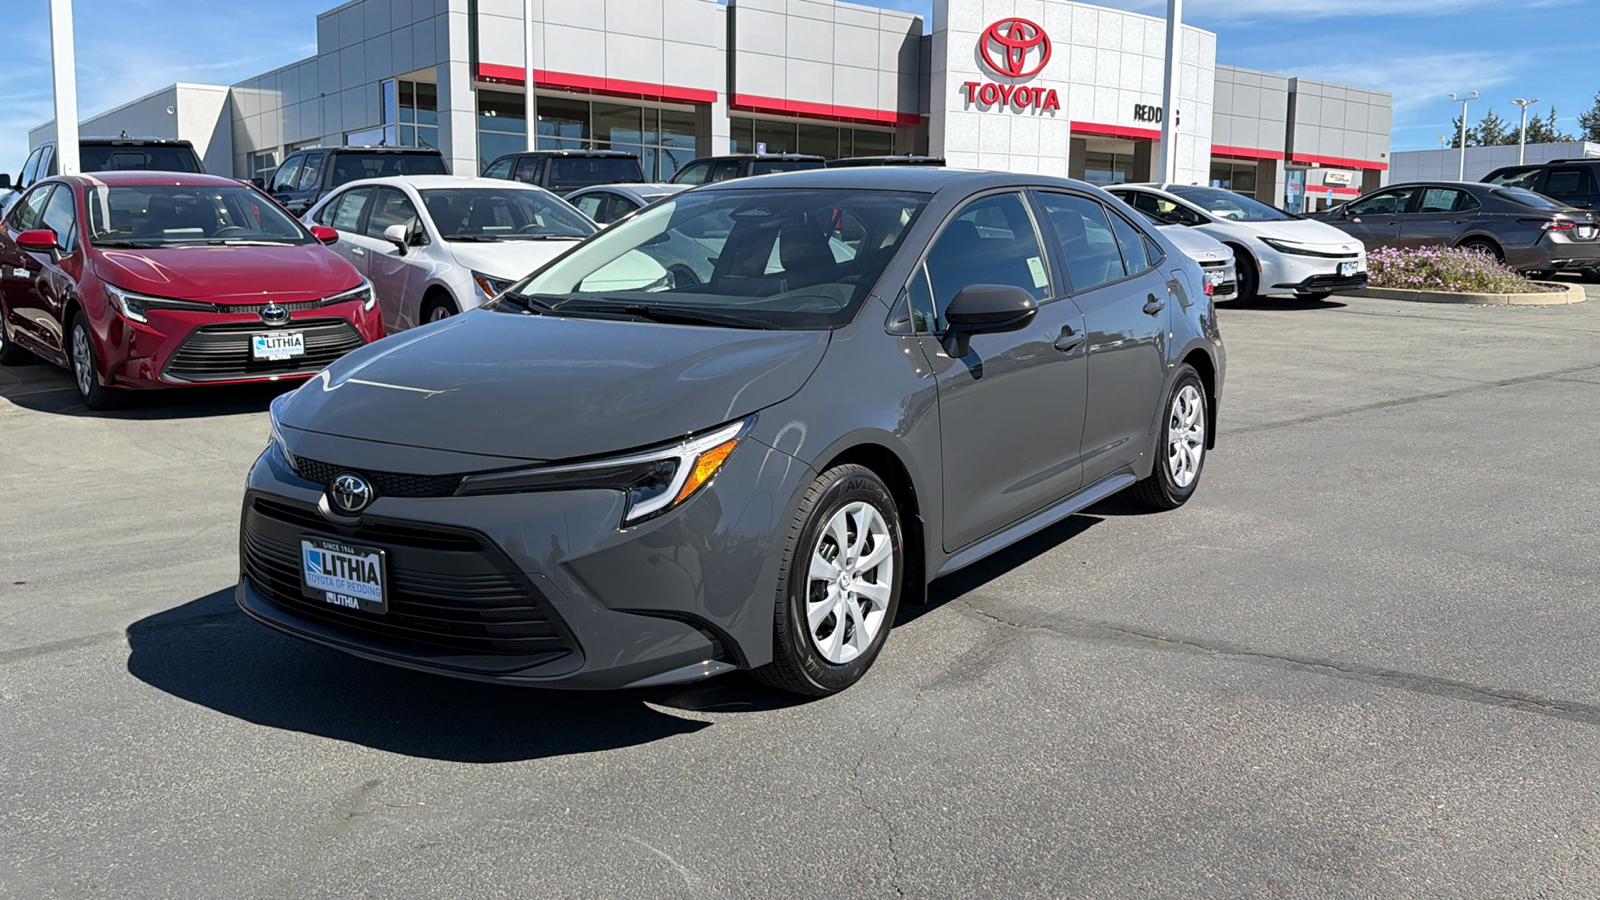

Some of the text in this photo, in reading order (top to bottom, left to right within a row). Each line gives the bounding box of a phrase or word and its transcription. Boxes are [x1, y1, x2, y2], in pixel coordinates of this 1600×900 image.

[963, 81, 1060, 110] TOYOTA
[266, 337, 301, 348] LITHIA
[323, 542, 340, 552] SINCE
[321, 552, 379, 586] LITHIA
[307, 572, 381, 597] TOYOTA OF REDDING
[333, 592, 360, 610] LITHIA
